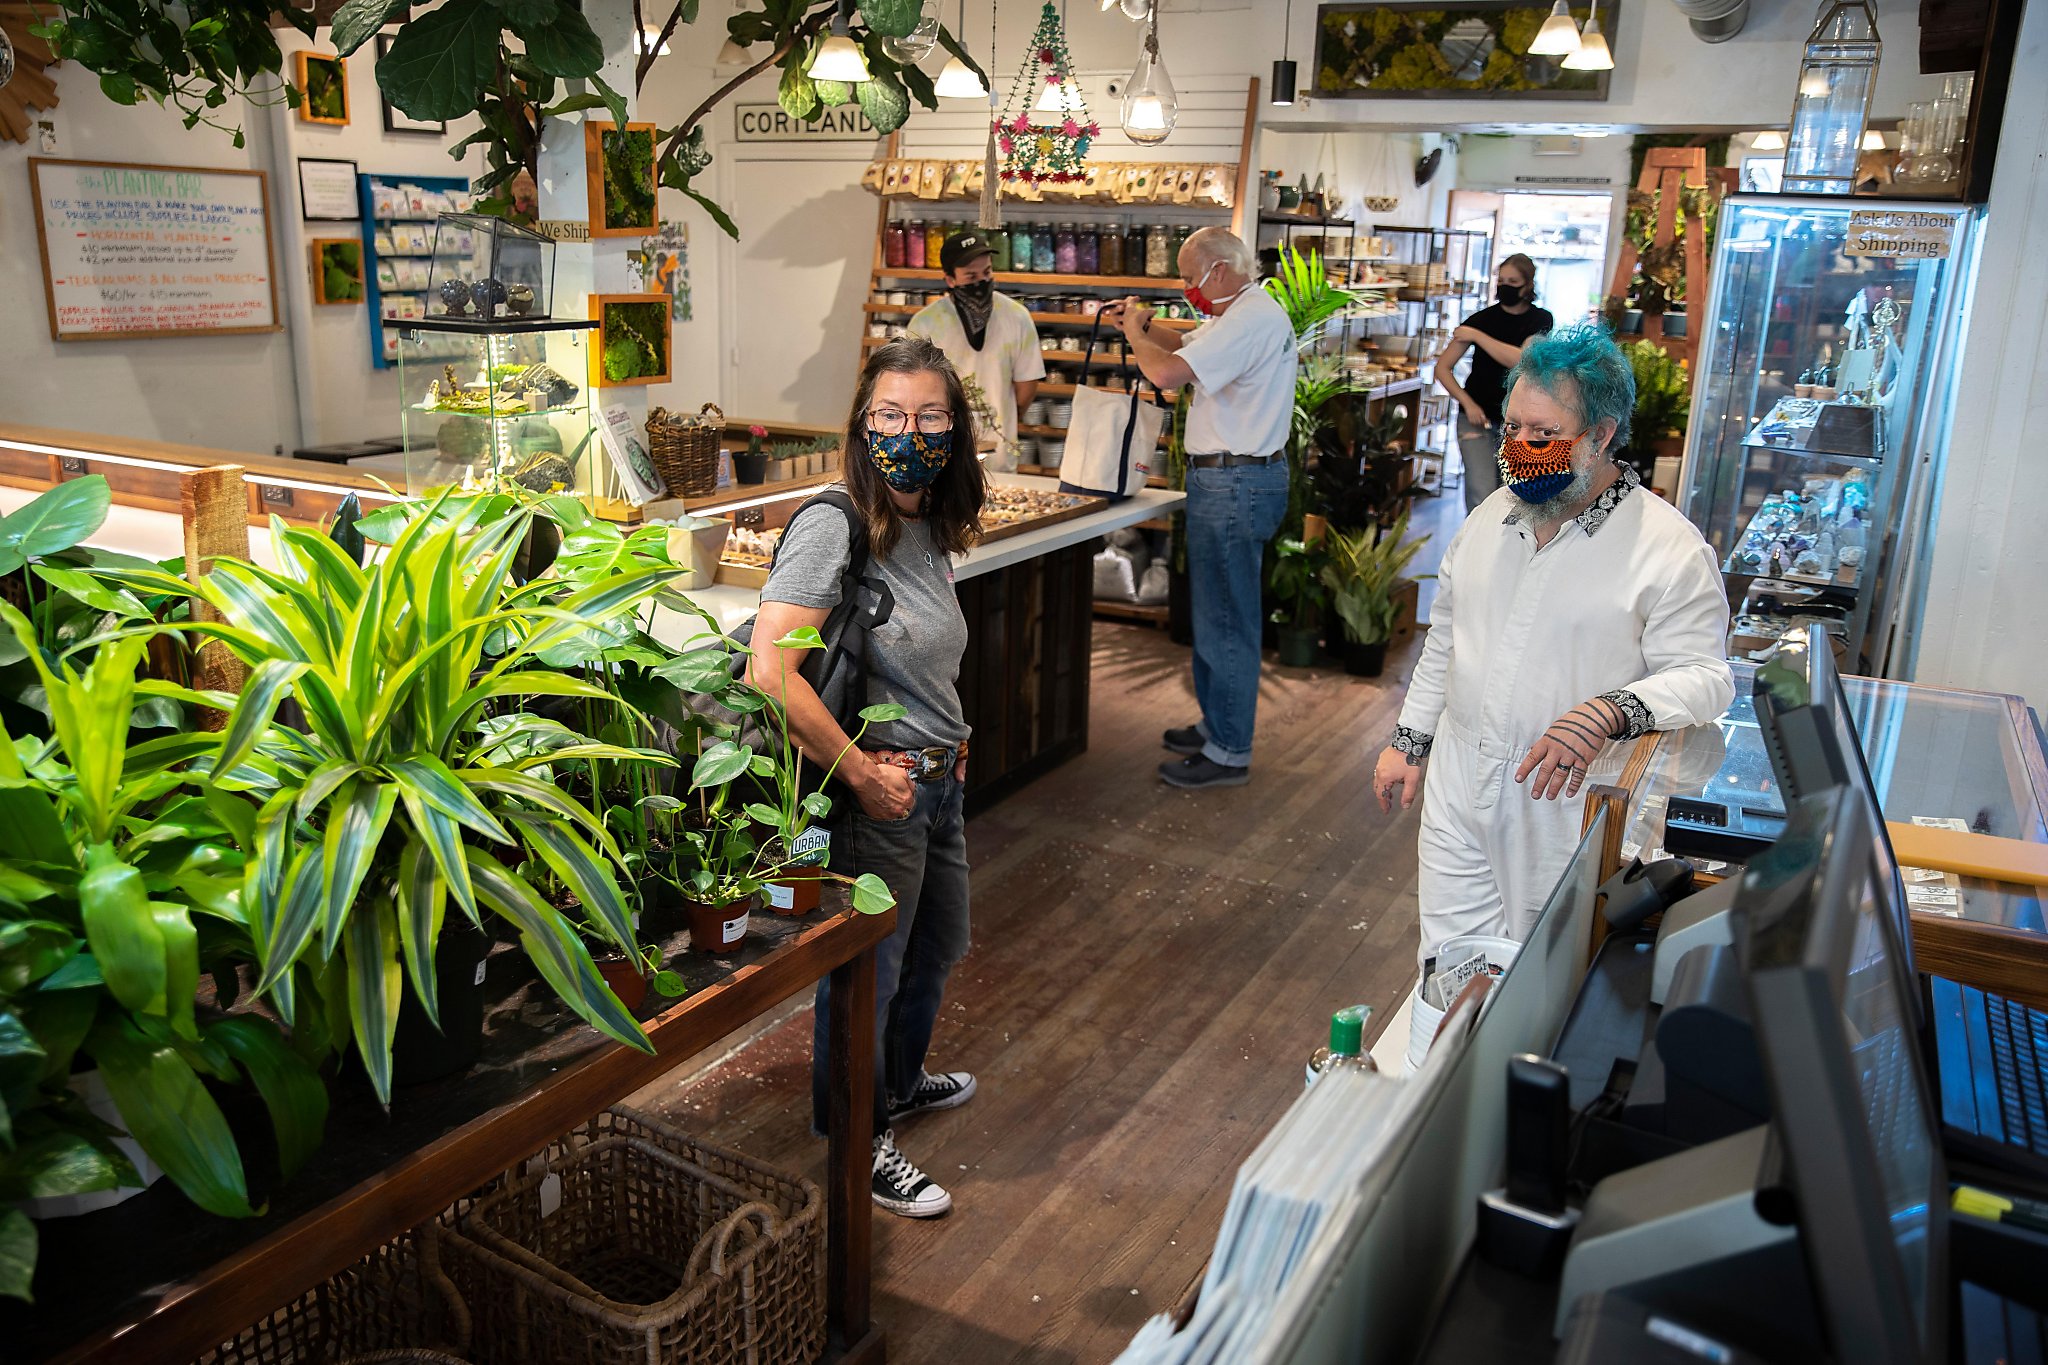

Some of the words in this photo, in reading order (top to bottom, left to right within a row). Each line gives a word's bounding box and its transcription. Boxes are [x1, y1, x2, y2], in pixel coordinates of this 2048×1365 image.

[102, 170, 172, 197] PLANTING
[175, 173, 214, 199] BAR
[51, 199, 69, 209] USE
[74, 200, 91, 209] THE
[96, 201, 135, 210] PLANTING
[105, 211, 143, 222] INCLUDE
[147, 211, 189, 222] SUPPLIES
[1850, 212, 1880, 226] Ask
[1885, 213, 1903, 227] Us
[1907, 212, 1956, 228] About
[91, 231, 154, 242] HORIZONTAL
[164, 233, 220, 244] PLANTERS
[540, 222, 561, 238] We
[564, 223, 591, 242] Ship
[961, 237, 976, 248] FTP
[1857, 237, 1940, 257] Shipping
[68, 273, 145, 287] TERRARIUMS
[795, 834, 827, 852] URBAN
